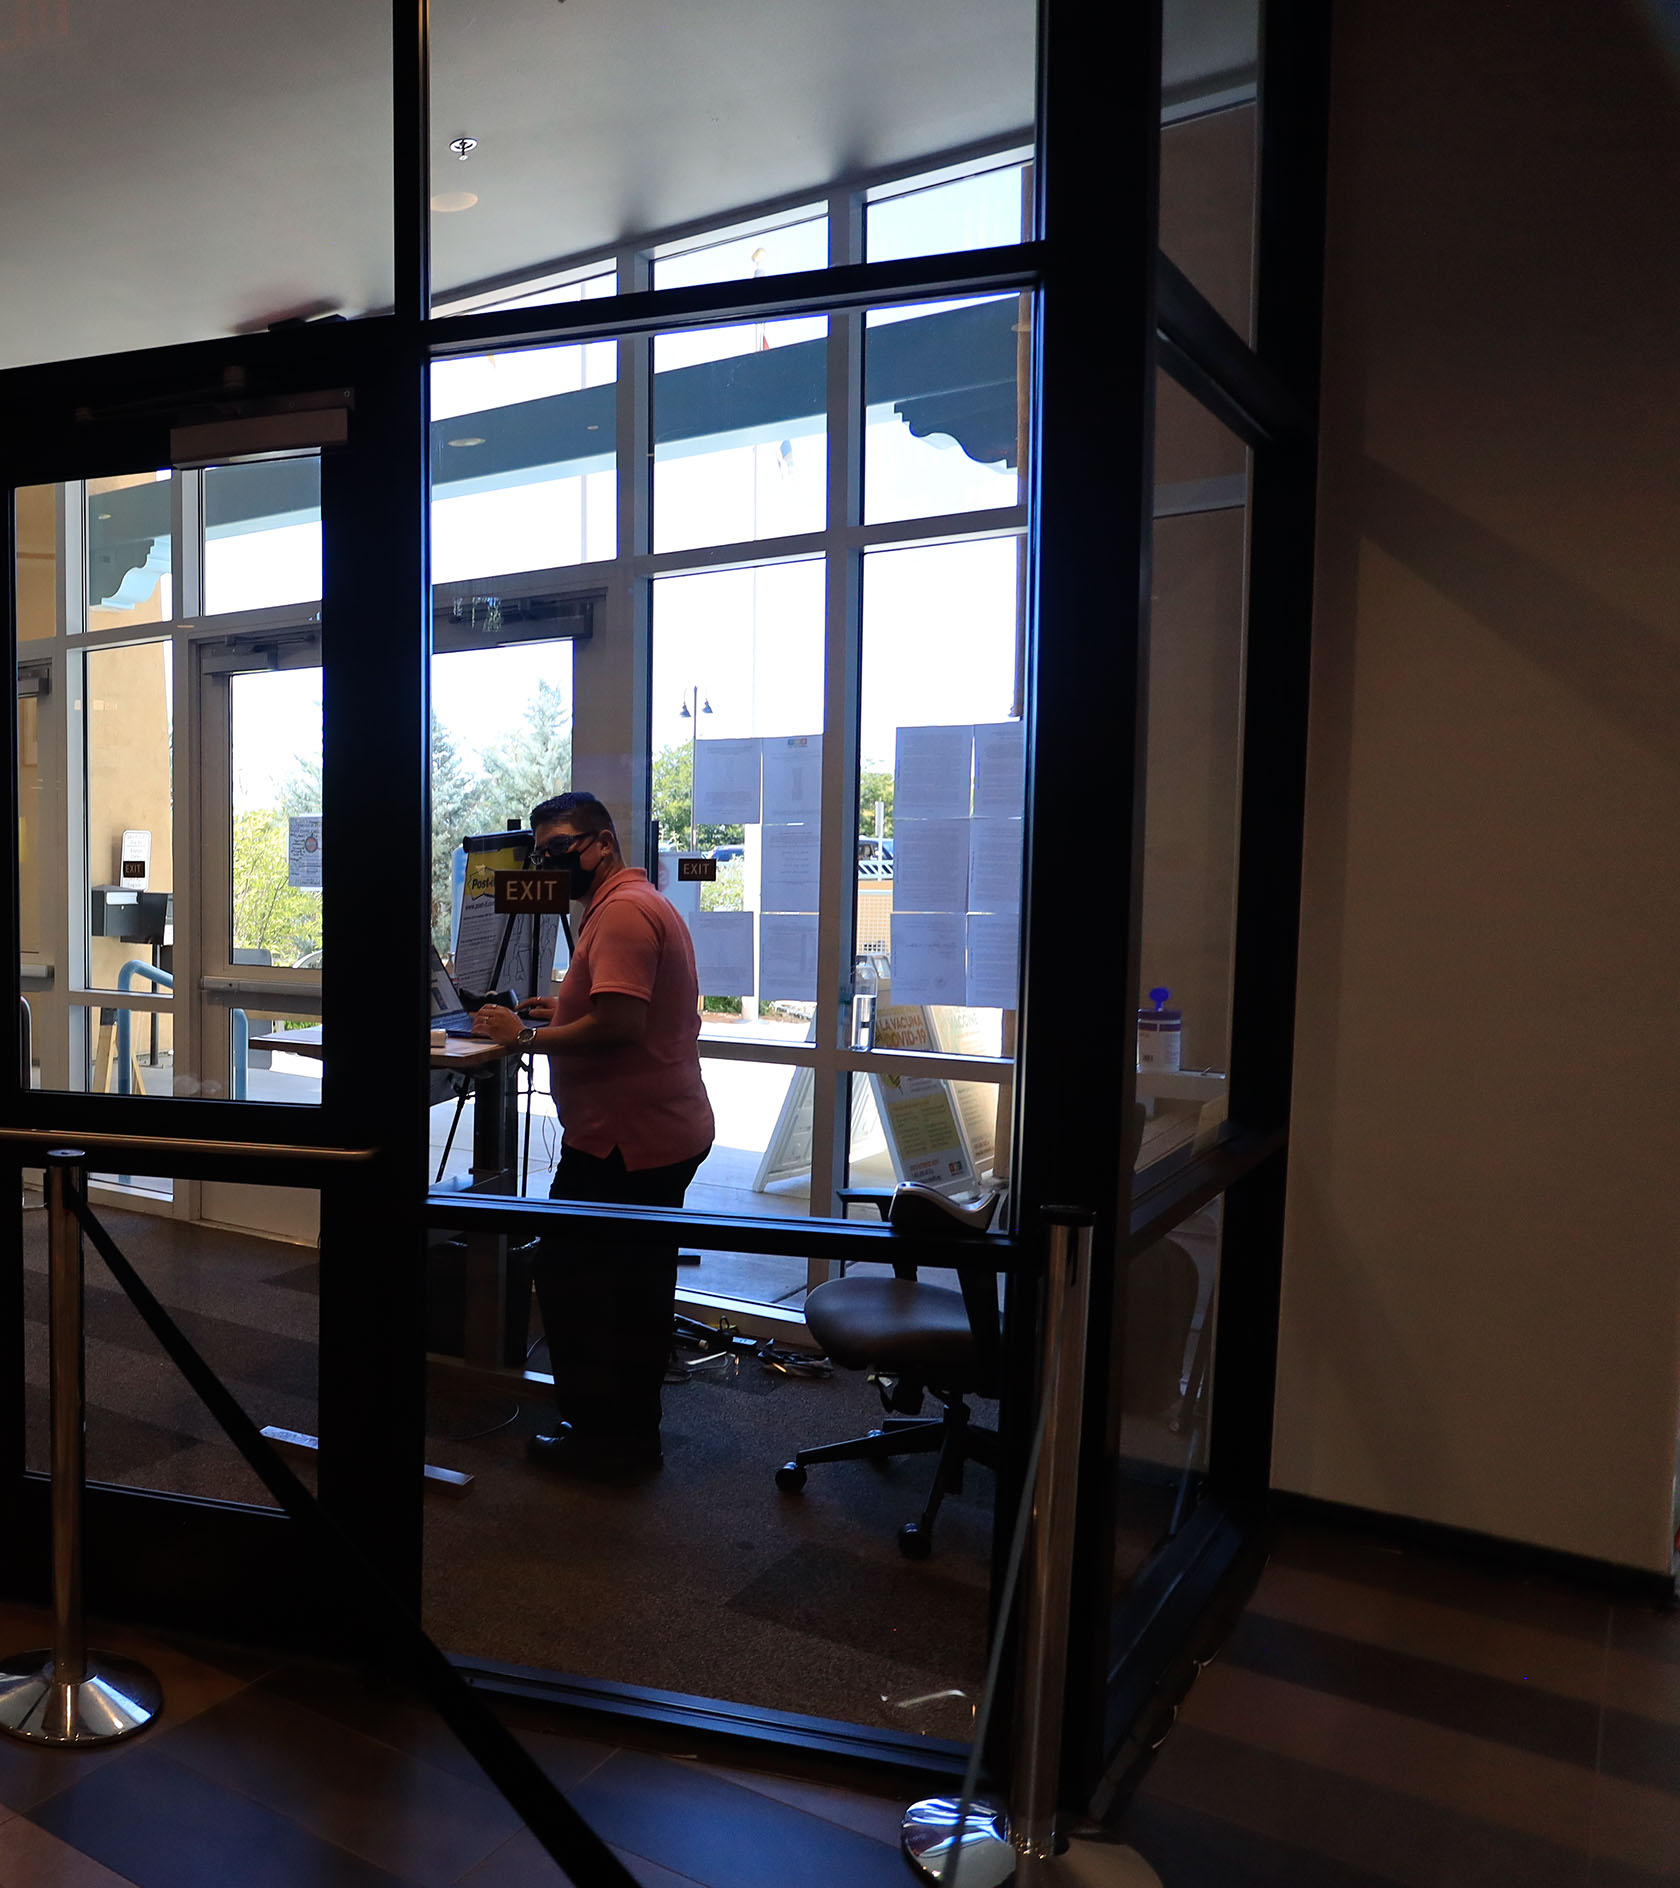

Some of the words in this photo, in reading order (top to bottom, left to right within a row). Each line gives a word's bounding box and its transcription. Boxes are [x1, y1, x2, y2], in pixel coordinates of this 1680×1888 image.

[125, 864, 141, 873] EXIT
[683, 863, 710, 875] EXIT
[507, 880, 558, 901] EXIT
[890, 1014, 923, 1030] VACUNA
